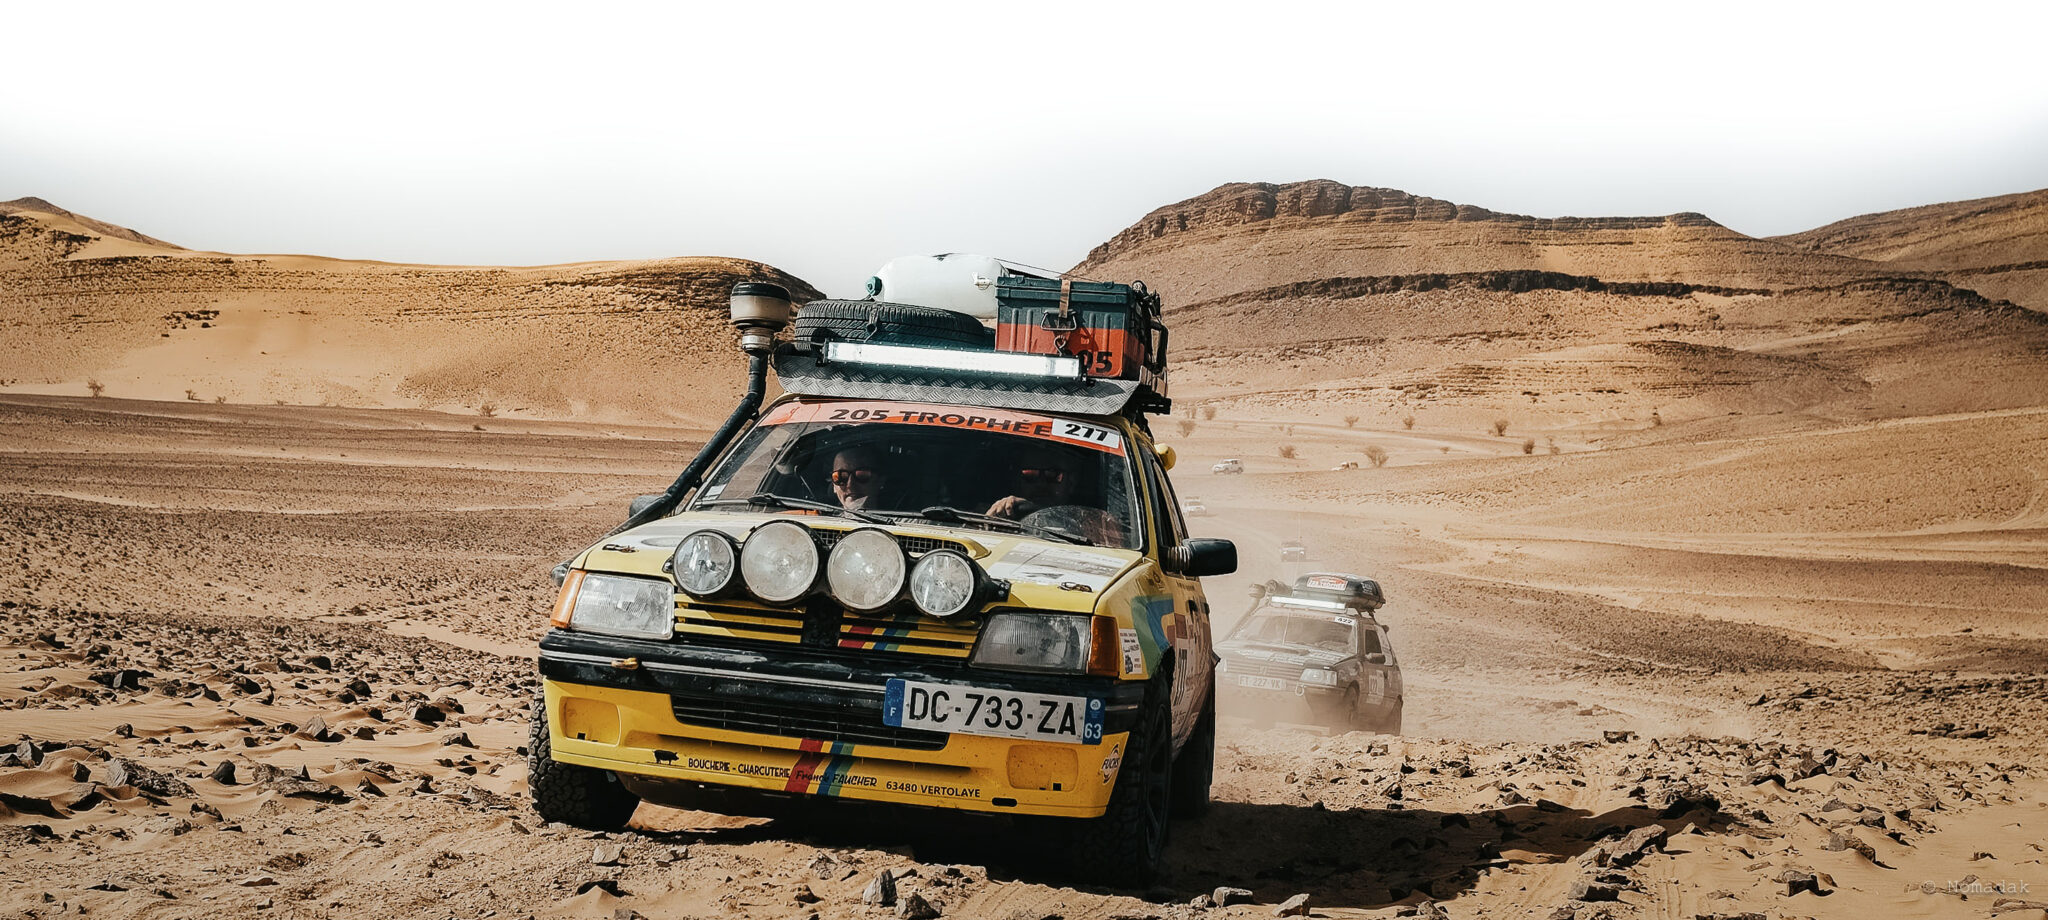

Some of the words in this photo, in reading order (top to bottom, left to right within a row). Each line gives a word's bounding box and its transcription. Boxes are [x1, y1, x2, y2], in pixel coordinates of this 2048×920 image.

[829, 409, 889, 420] 205
[899, 411, 1051, 437] TROPHÉE
[1065, 423, 1108, 441] 277
[889, 707, 896, 717] F
[909, 687, 1077, 736] DC-733-ZA
[1084, 723, 1102, 739] 63
[1101, 757, 1120, 770] FUCHS
[688, 758, 730, 772] BOUCHERIE
[738, 764, 790, 778] CHARCUTERIE
[831, 774, 877, 787] FAUCHER
[886, 781, 917, 793] 63480
[920, 784, 980, 798] VERTOLAYE
